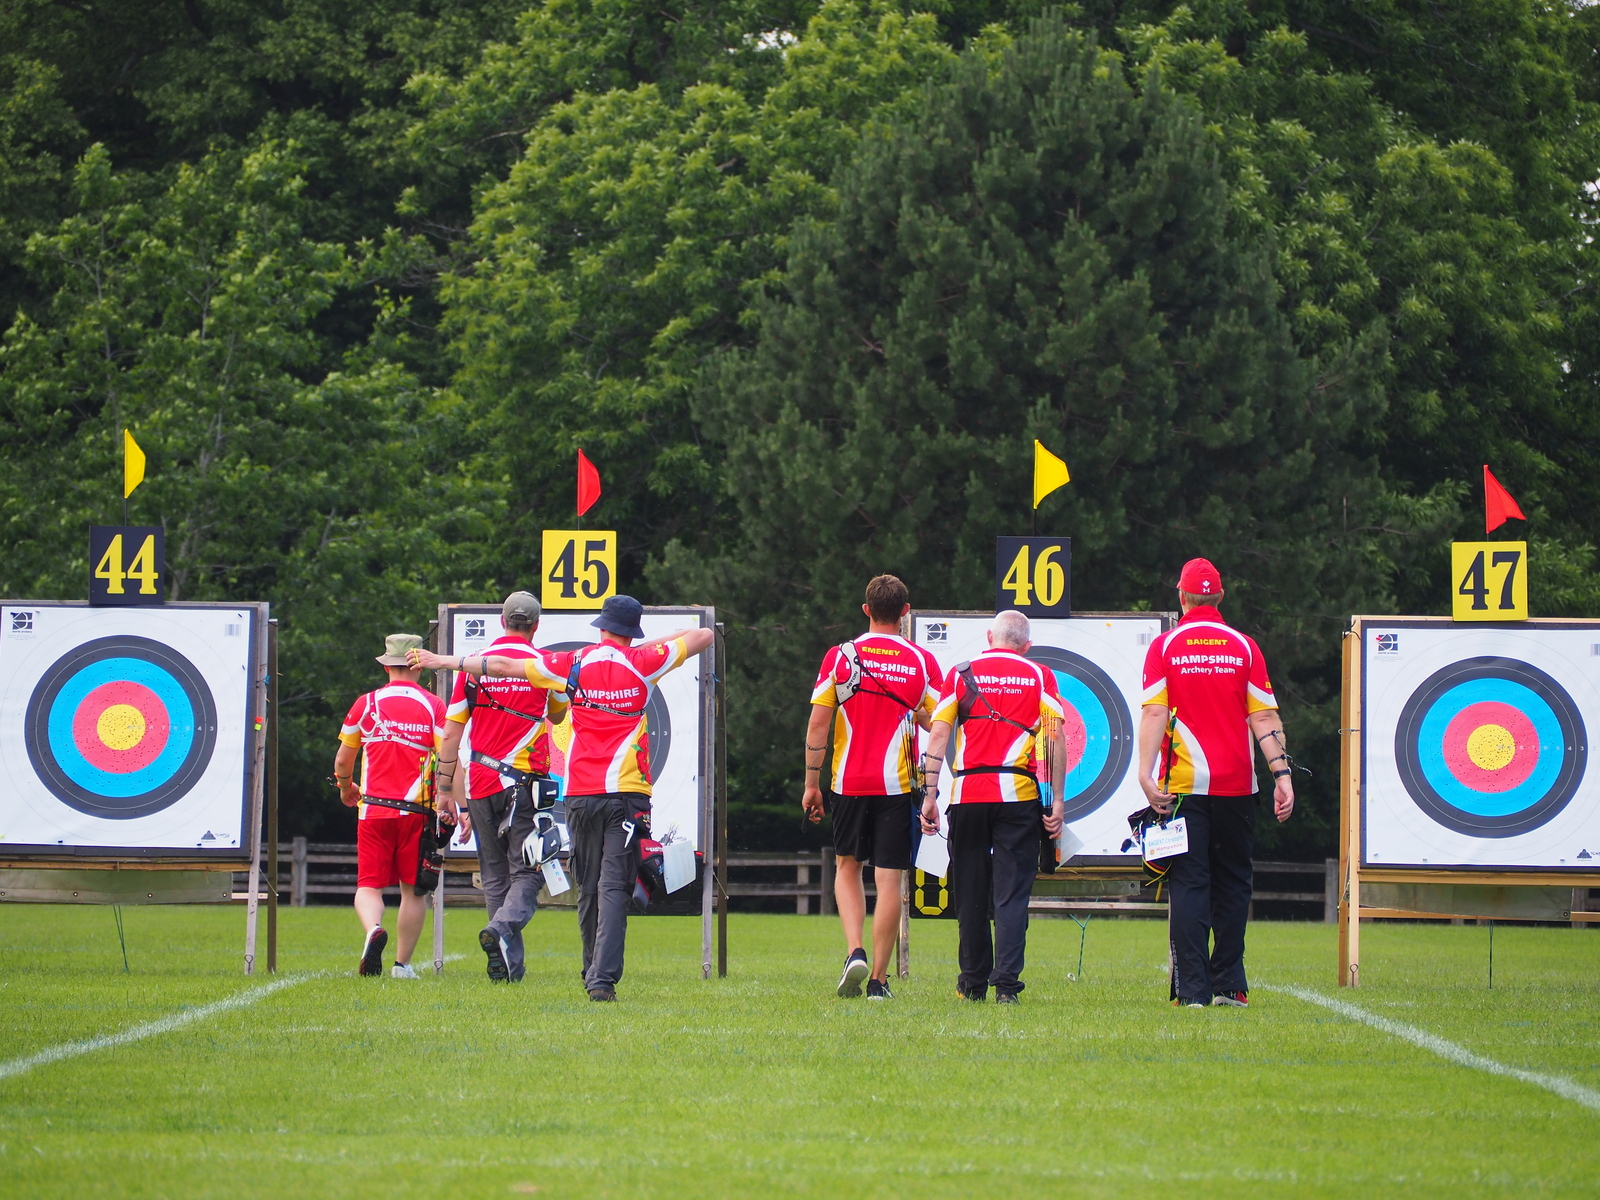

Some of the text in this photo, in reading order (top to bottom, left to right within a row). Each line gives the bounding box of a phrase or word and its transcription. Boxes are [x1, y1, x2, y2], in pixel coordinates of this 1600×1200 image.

[95, 533, 159, 595] 44
[548, 538, 610, 599] 45
[1002, 544, 1065, 607] 46
[1458, 550, 1521, 611] 47
[1186, 638, 1228, 646] BAIGENT
[861, 646, 901, 657] EMENEY
[1171, 654, 1244, 667] HAMPSHIRE
[845, 659, 917, 676] HMPSHIRE
[1181, 666, 1236, 676] Archery Team
[480, 675, 529, 684] AMPSH
[861, 670, 907, 684] rchery Team
[964, 675, 1036, 687] AMPSHIRE
[978, 686, 1022, 695] Archery Team
[611, 701, 633, 709] Team
[376, 719, 431, 734] MPSHIRE
[403, 732, 422, 740] Team
[1156, 842, 1183, 852] Hampshire
